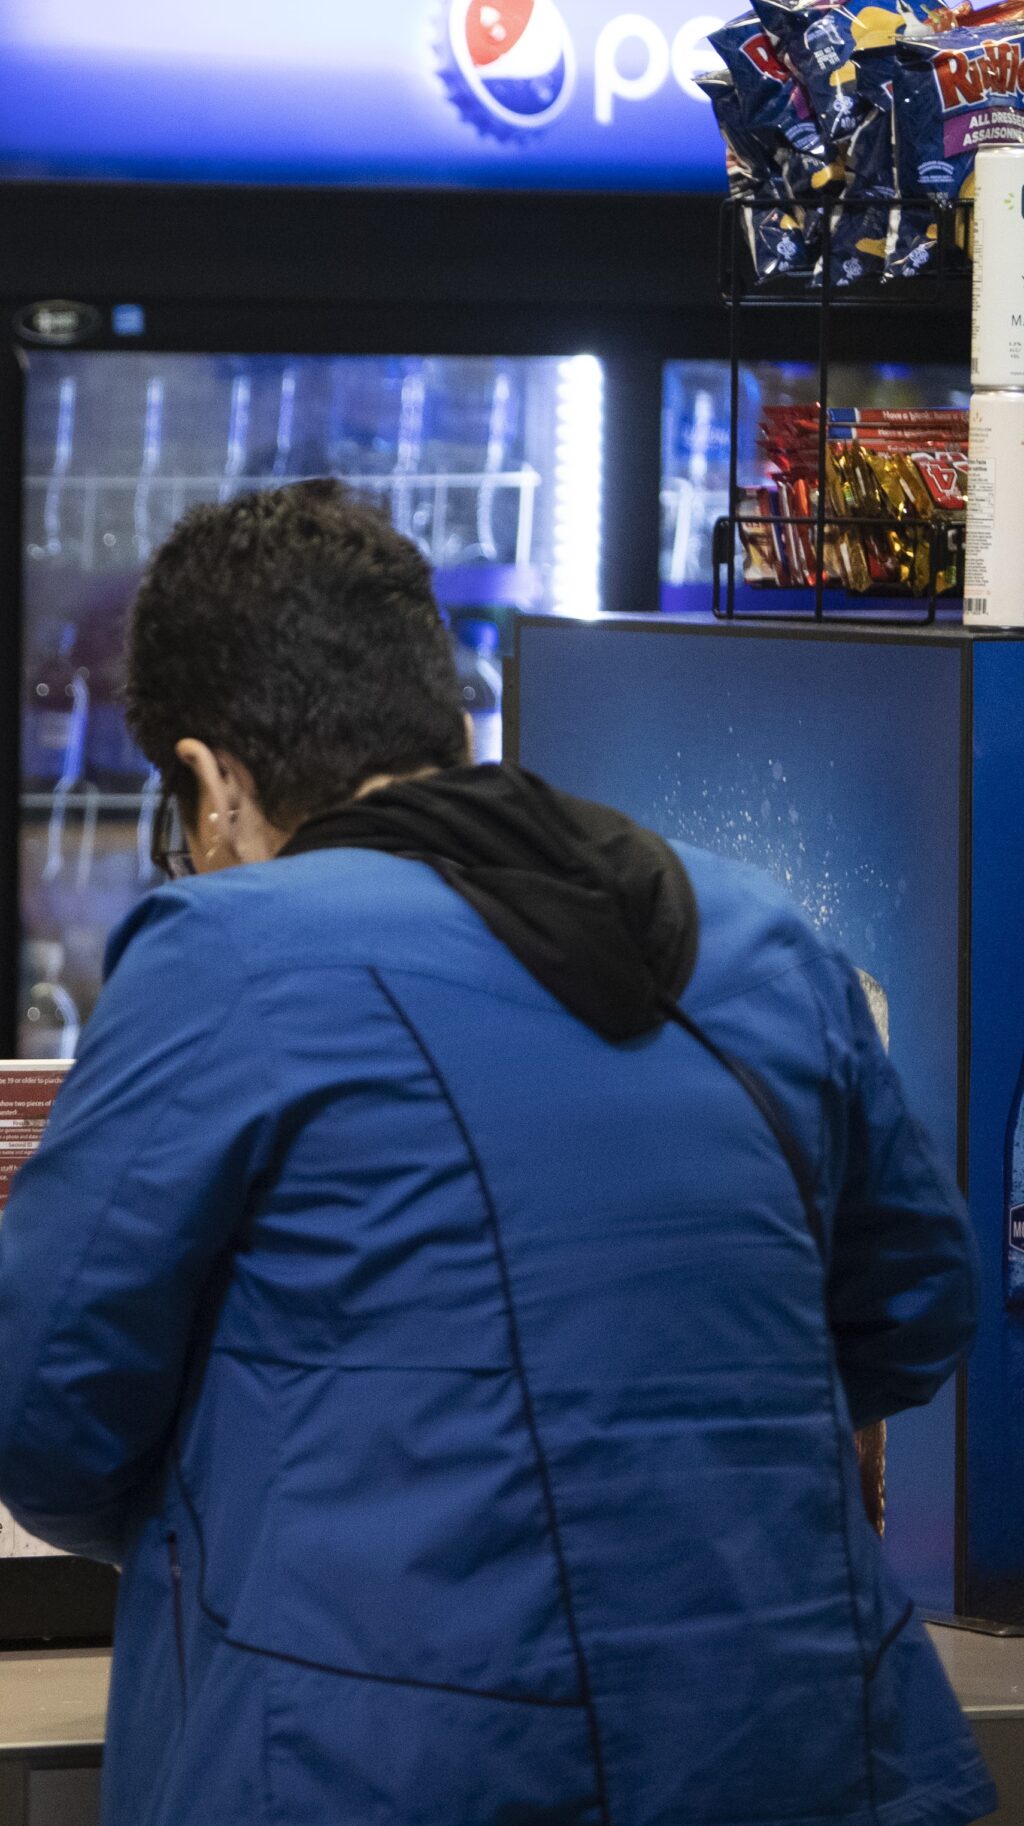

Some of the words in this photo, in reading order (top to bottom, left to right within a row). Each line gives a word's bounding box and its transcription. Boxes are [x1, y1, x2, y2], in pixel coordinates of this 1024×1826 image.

[594, 14, 728, 125] pe
[969, 113, 990, 129] ALL
[44, 1077, 63, 1085] purch
[26, 1100, 44, 1108] pieces
